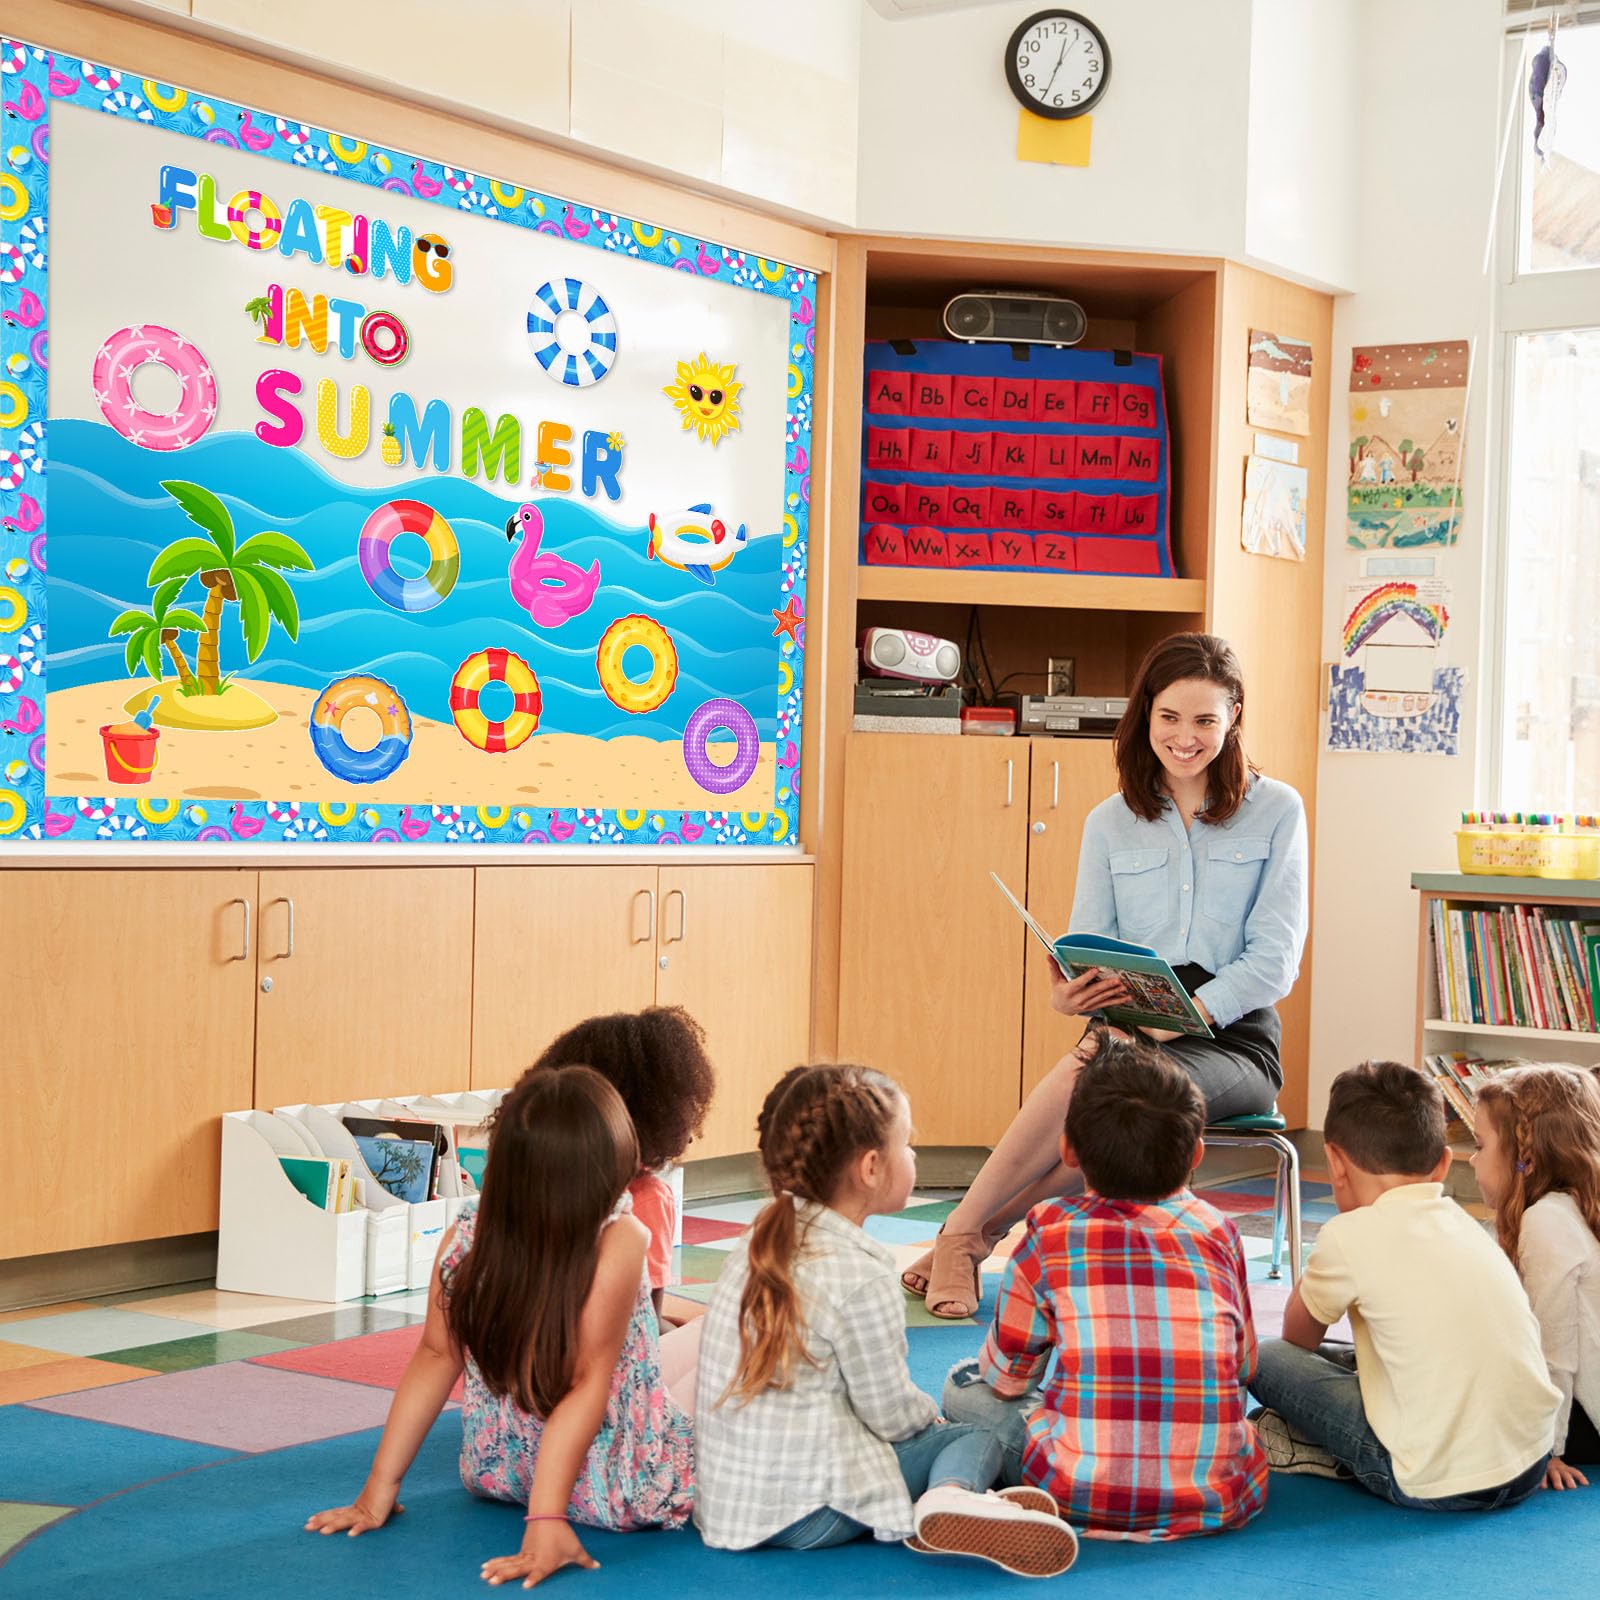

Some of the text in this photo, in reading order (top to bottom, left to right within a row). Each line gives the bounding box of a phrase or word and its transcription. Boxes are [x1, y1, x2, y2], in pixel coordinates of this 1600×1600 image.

[1036, 27, 1048, 39] 11
[1051, 22, 1067, 34] 12
[1074, 29, 1079, 40] 1
[1024, 40, 1040, 52] 10
[1084, 41, 1094, 53] 2
[1019, 56, 1029, 68] 9
[1088, 60, 1098, 72] 3
[1025, 74, 1035, 87] 8
[1082, 78, 1093, 90] 4
[1039, 89, 1048, 100] 7
[1053, 94, 1063, 106] 6
[1072, 90, 1080, 101] 5
[157, 165, 453, 293] FLOATING
[264, 284, 410, 366] INTO
[877, 384, 1149, 417] Aa Bb Cc Dd Ee Ff Gg
[255, 369, 623, 501] SUMMER
[878, 441, 1151, 468] Hh Ii Jj Kk Ll Mm Nn
[872, 496, 1144, 524] Oo Pp Qq Rr Ss Tt Uu
[876, 536, 1066, 560] Vv Ww Xx Yy Zz
